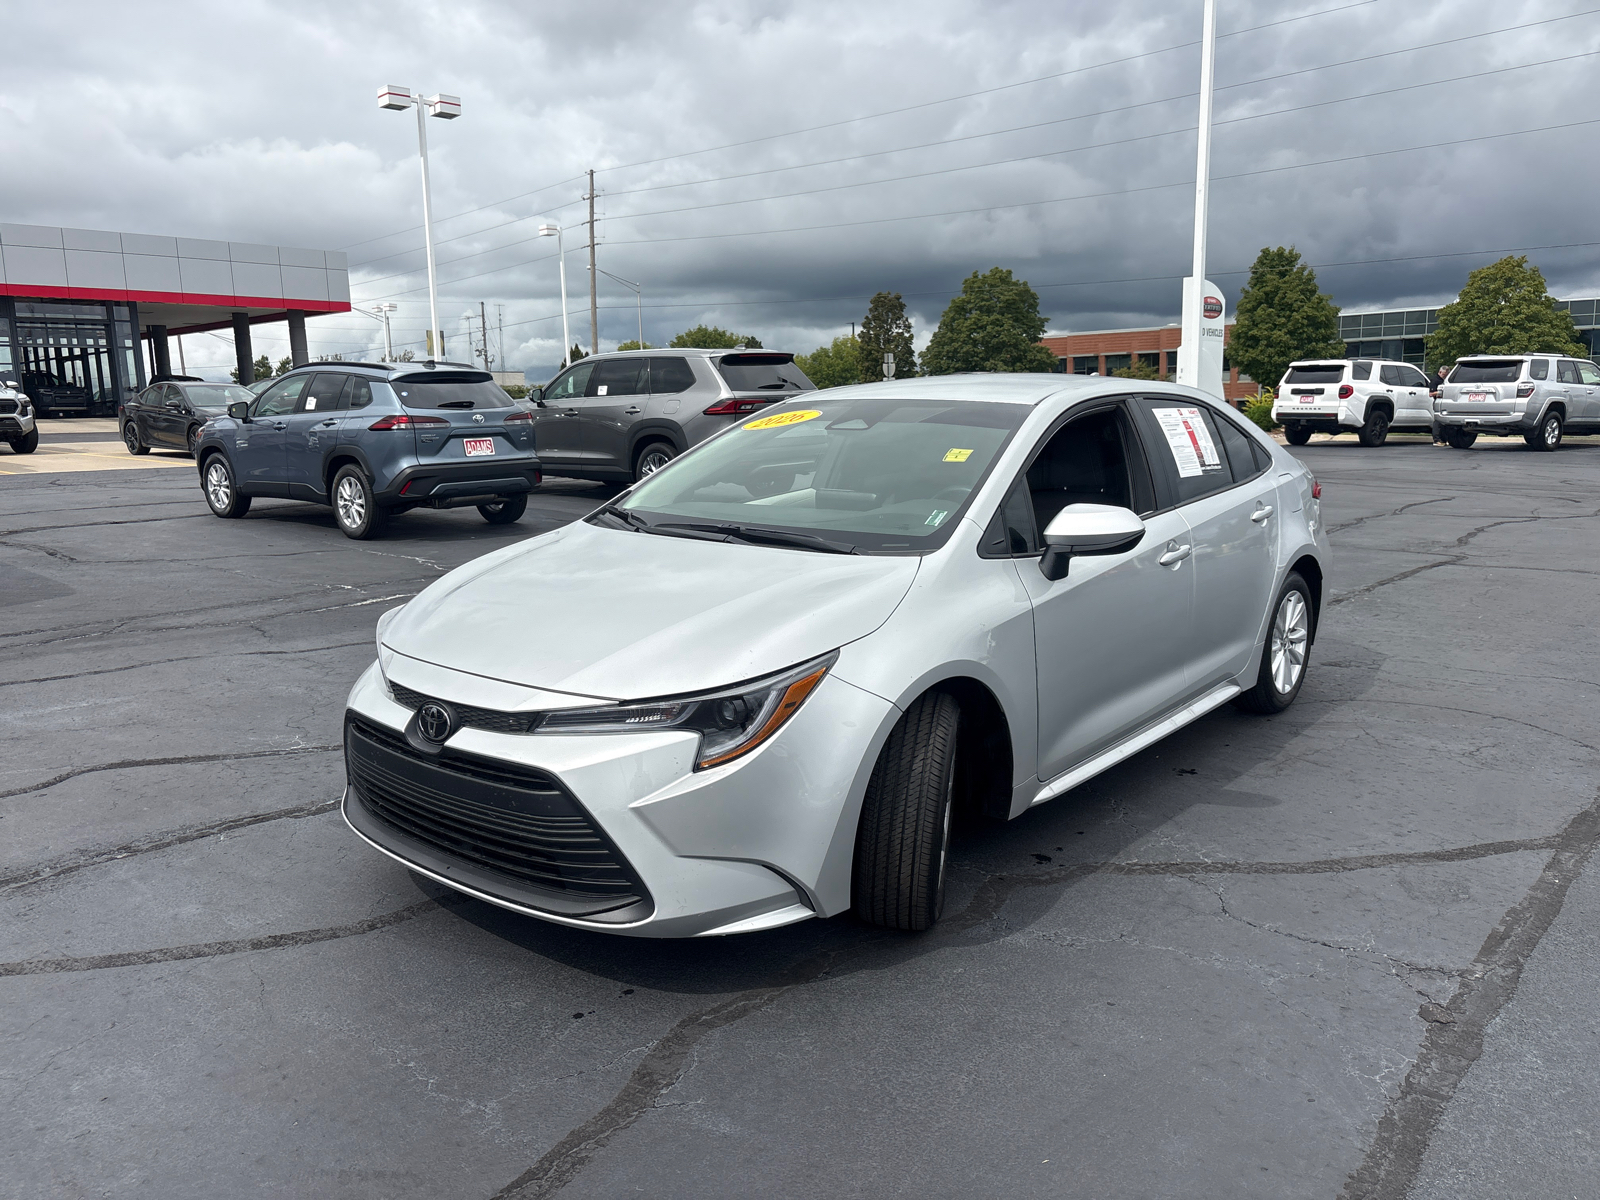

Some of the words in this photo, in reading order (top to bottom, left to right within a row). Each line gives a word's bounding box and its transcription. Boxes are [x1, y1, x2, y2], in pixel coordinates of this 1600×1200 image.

[1206, 328, 1223, 337] VEHICLES
[750, 411, 813, 428] 2026
[465, 440, 493, 453] ADAMS
